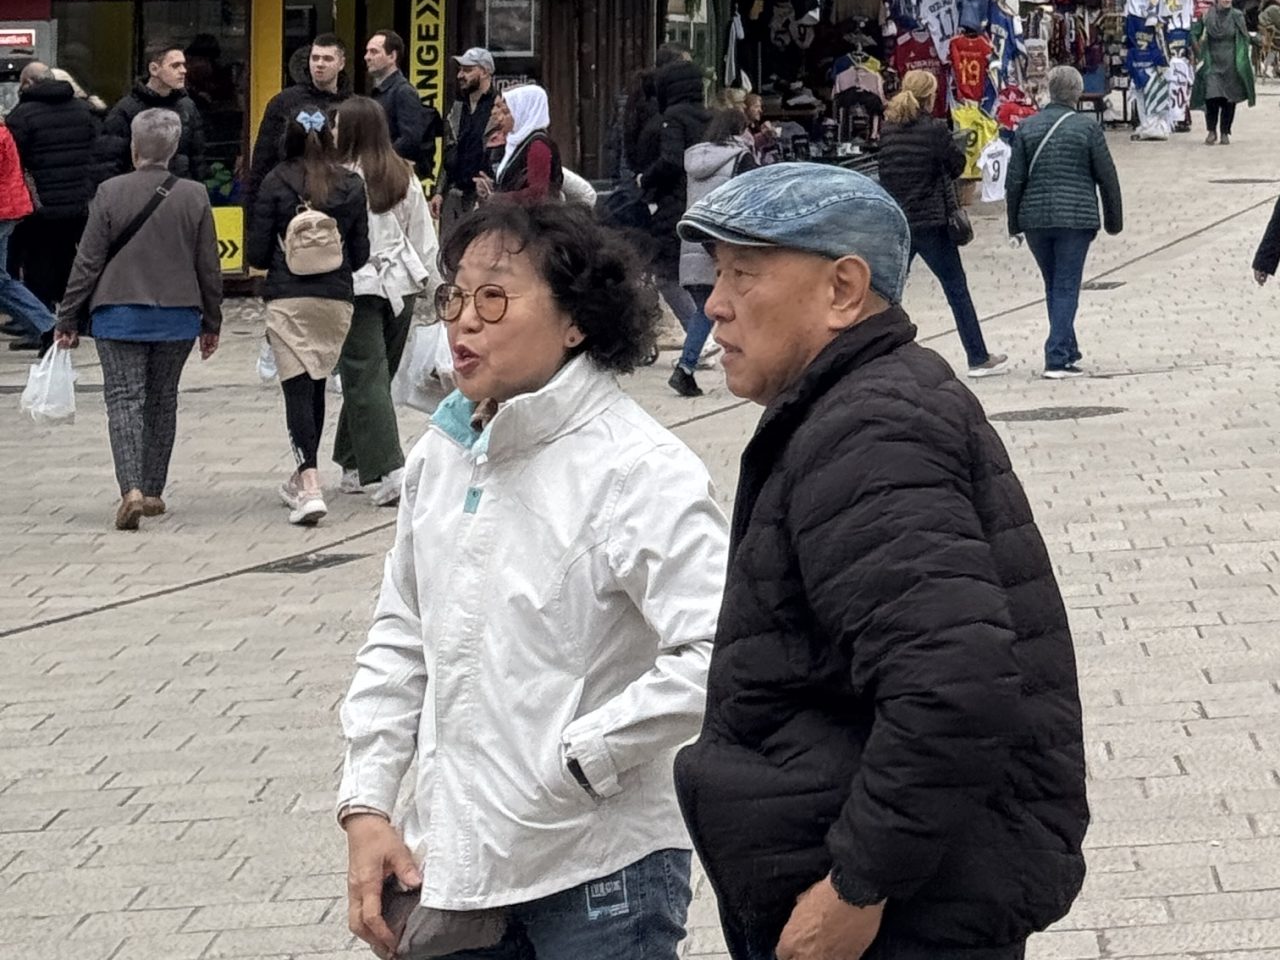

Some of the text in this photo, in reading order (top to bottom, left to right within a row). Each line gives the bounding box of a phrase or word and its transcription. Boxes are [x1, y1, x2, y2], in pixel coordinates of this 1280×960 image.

[416, 23, 440, 110] ANGE
[960, 58, 981, 86] 19
[991, 160, 1001, 182] 9
